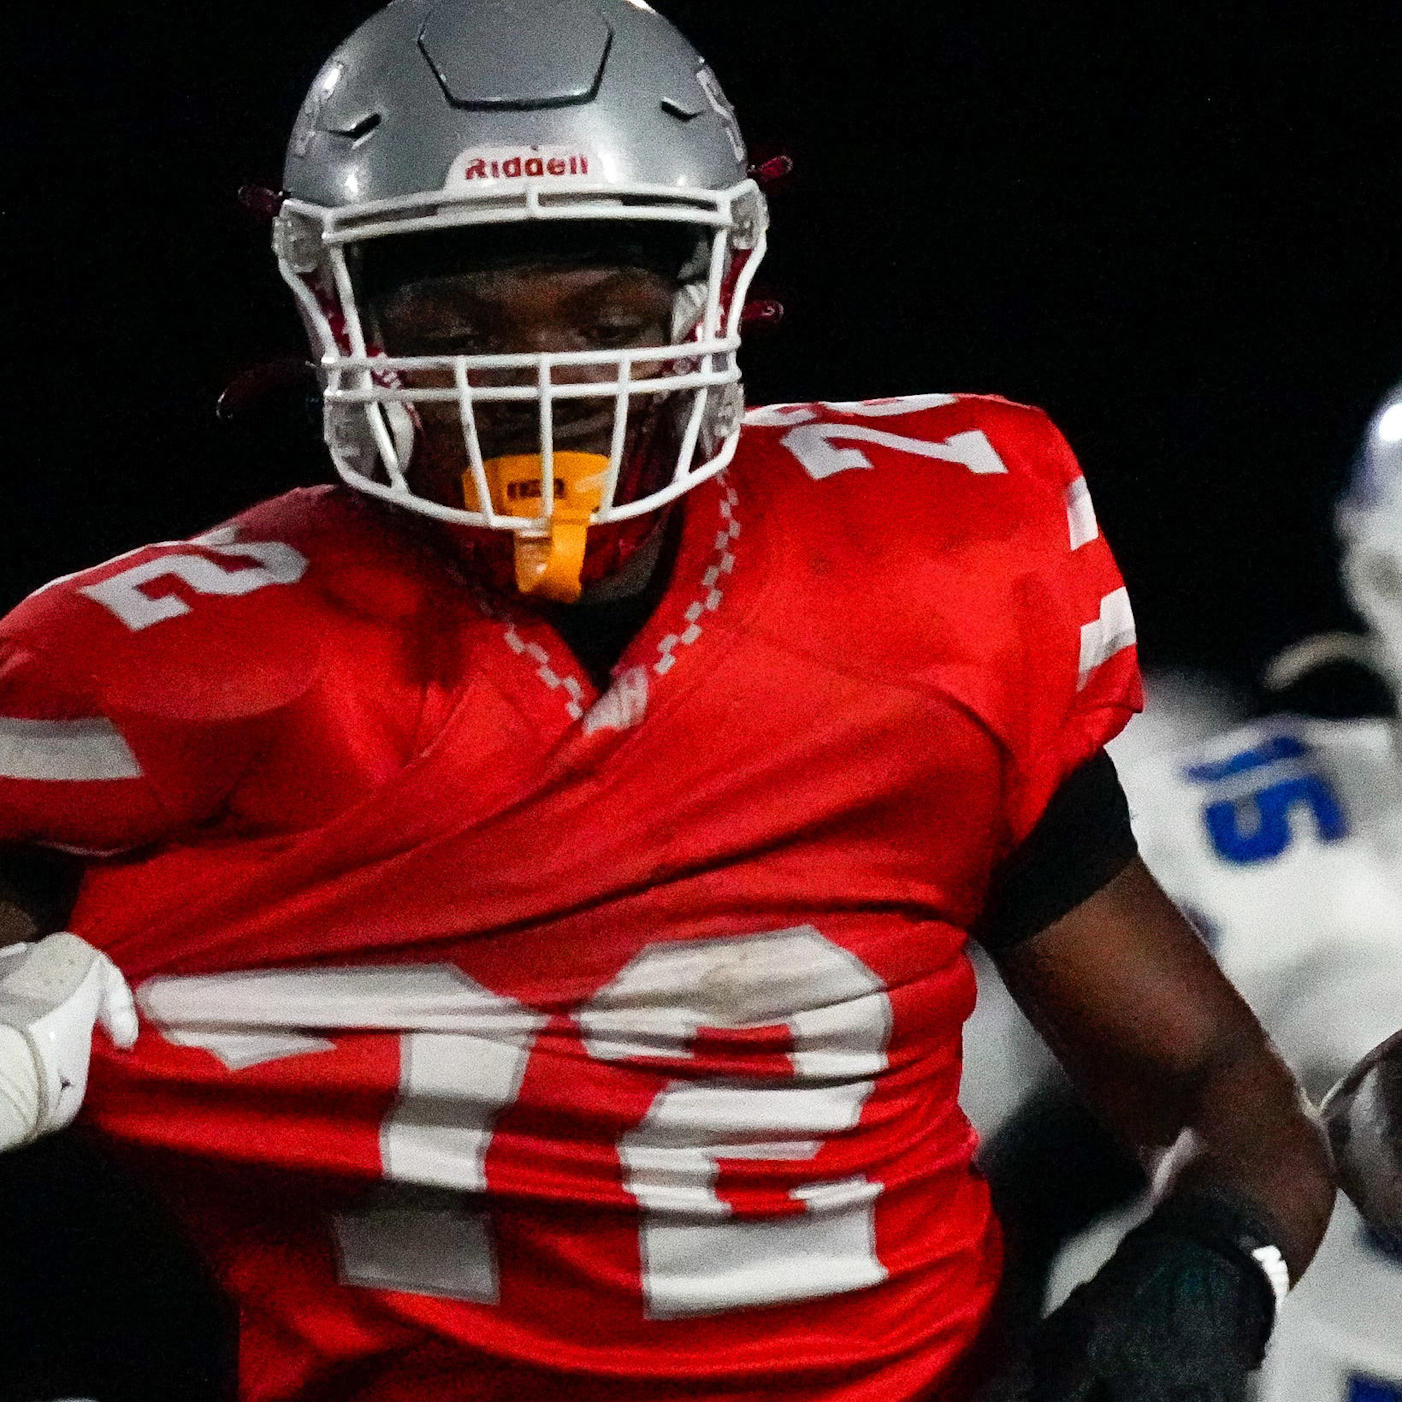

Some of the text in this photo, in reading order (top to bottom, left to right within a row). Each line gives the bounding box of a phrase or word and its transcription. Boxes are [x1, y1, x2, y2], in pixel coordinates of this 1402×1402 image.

[465, 154, 588, 180] Riddell
[79, 525, 310, 632] 2
[133, 923, 895, 1322] 72
